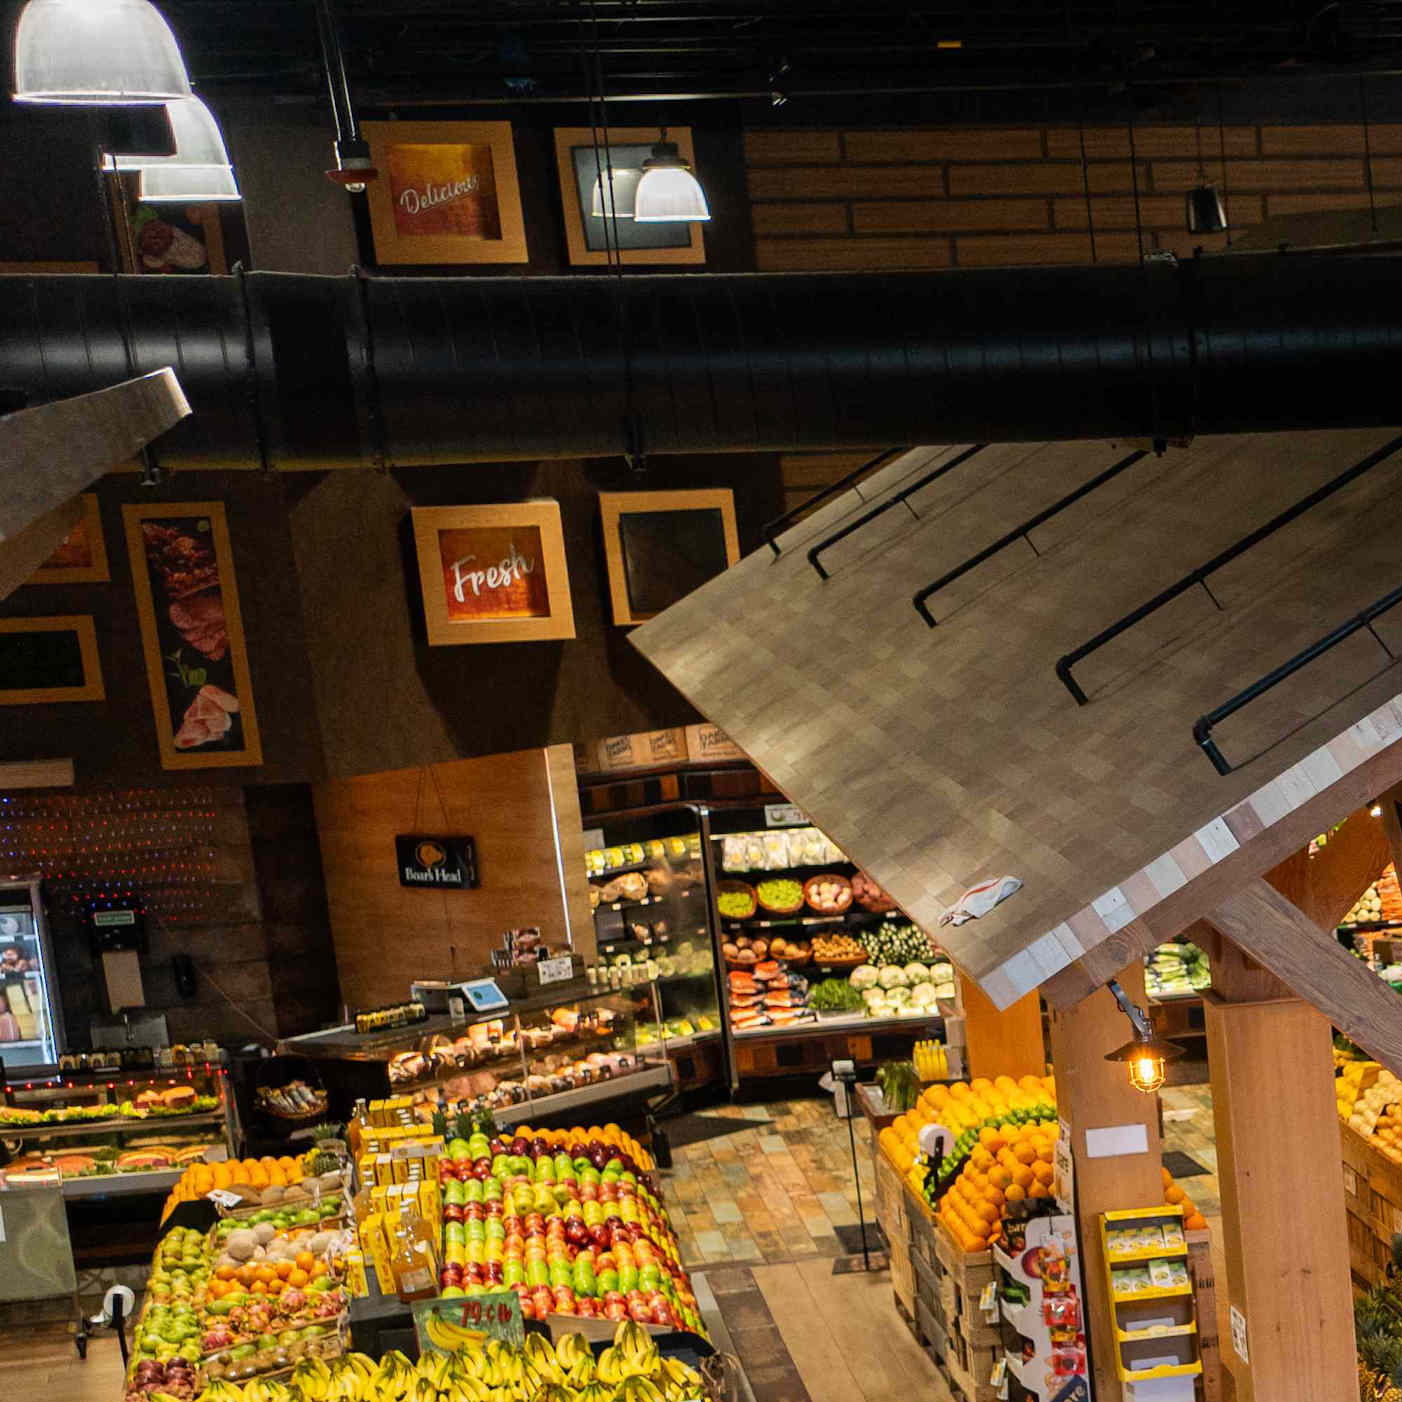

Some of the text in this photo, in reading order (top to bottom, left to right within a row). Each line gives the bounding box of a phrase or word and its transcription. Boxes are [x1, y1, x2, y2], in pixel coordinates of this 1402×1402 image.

[449, 543, 535, 603] Fresh
[405, 866, 462, 883] Boar's Head
